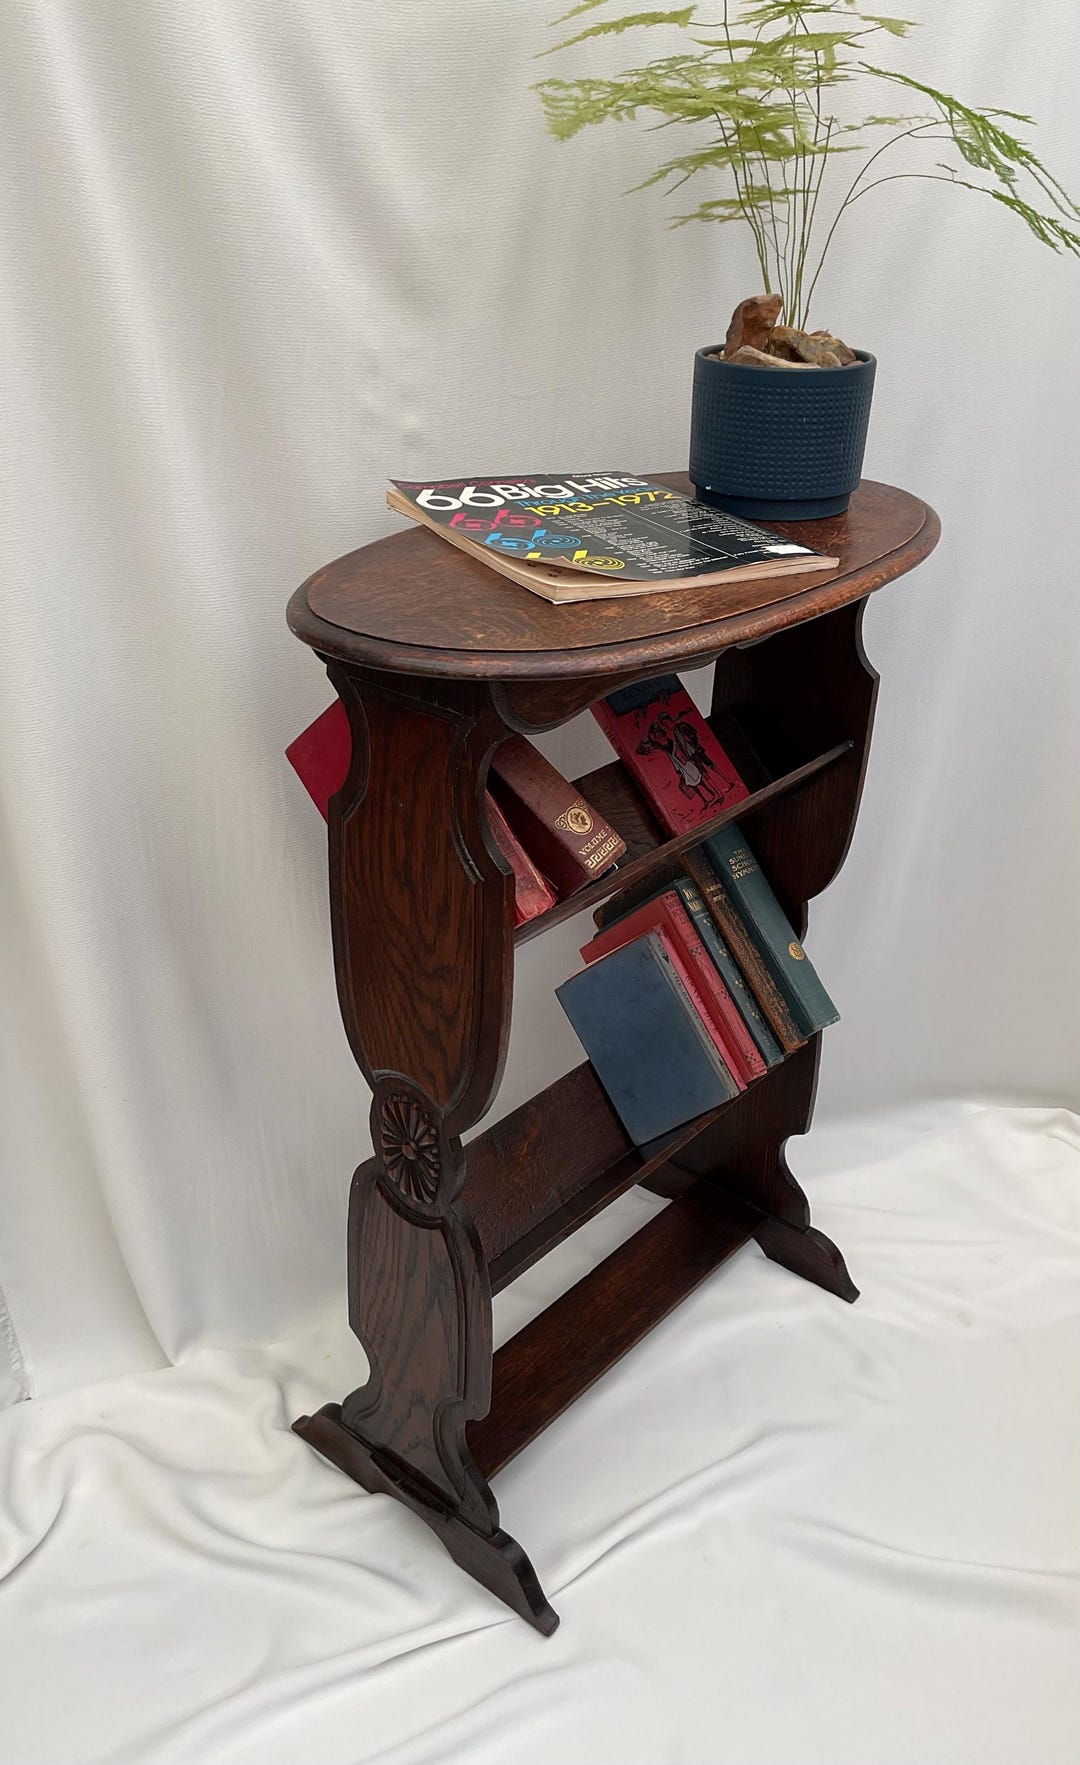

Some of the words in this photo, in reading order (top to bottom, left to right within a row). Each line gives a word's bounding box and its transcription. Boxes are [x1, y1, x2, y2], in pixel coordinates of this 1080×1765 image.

[415, 486, 505, 511] 66
[491, 484, 575, 499] Big
[564, 476, 649, 493] Hits
[579, 829, 608, 855] VOLUME
